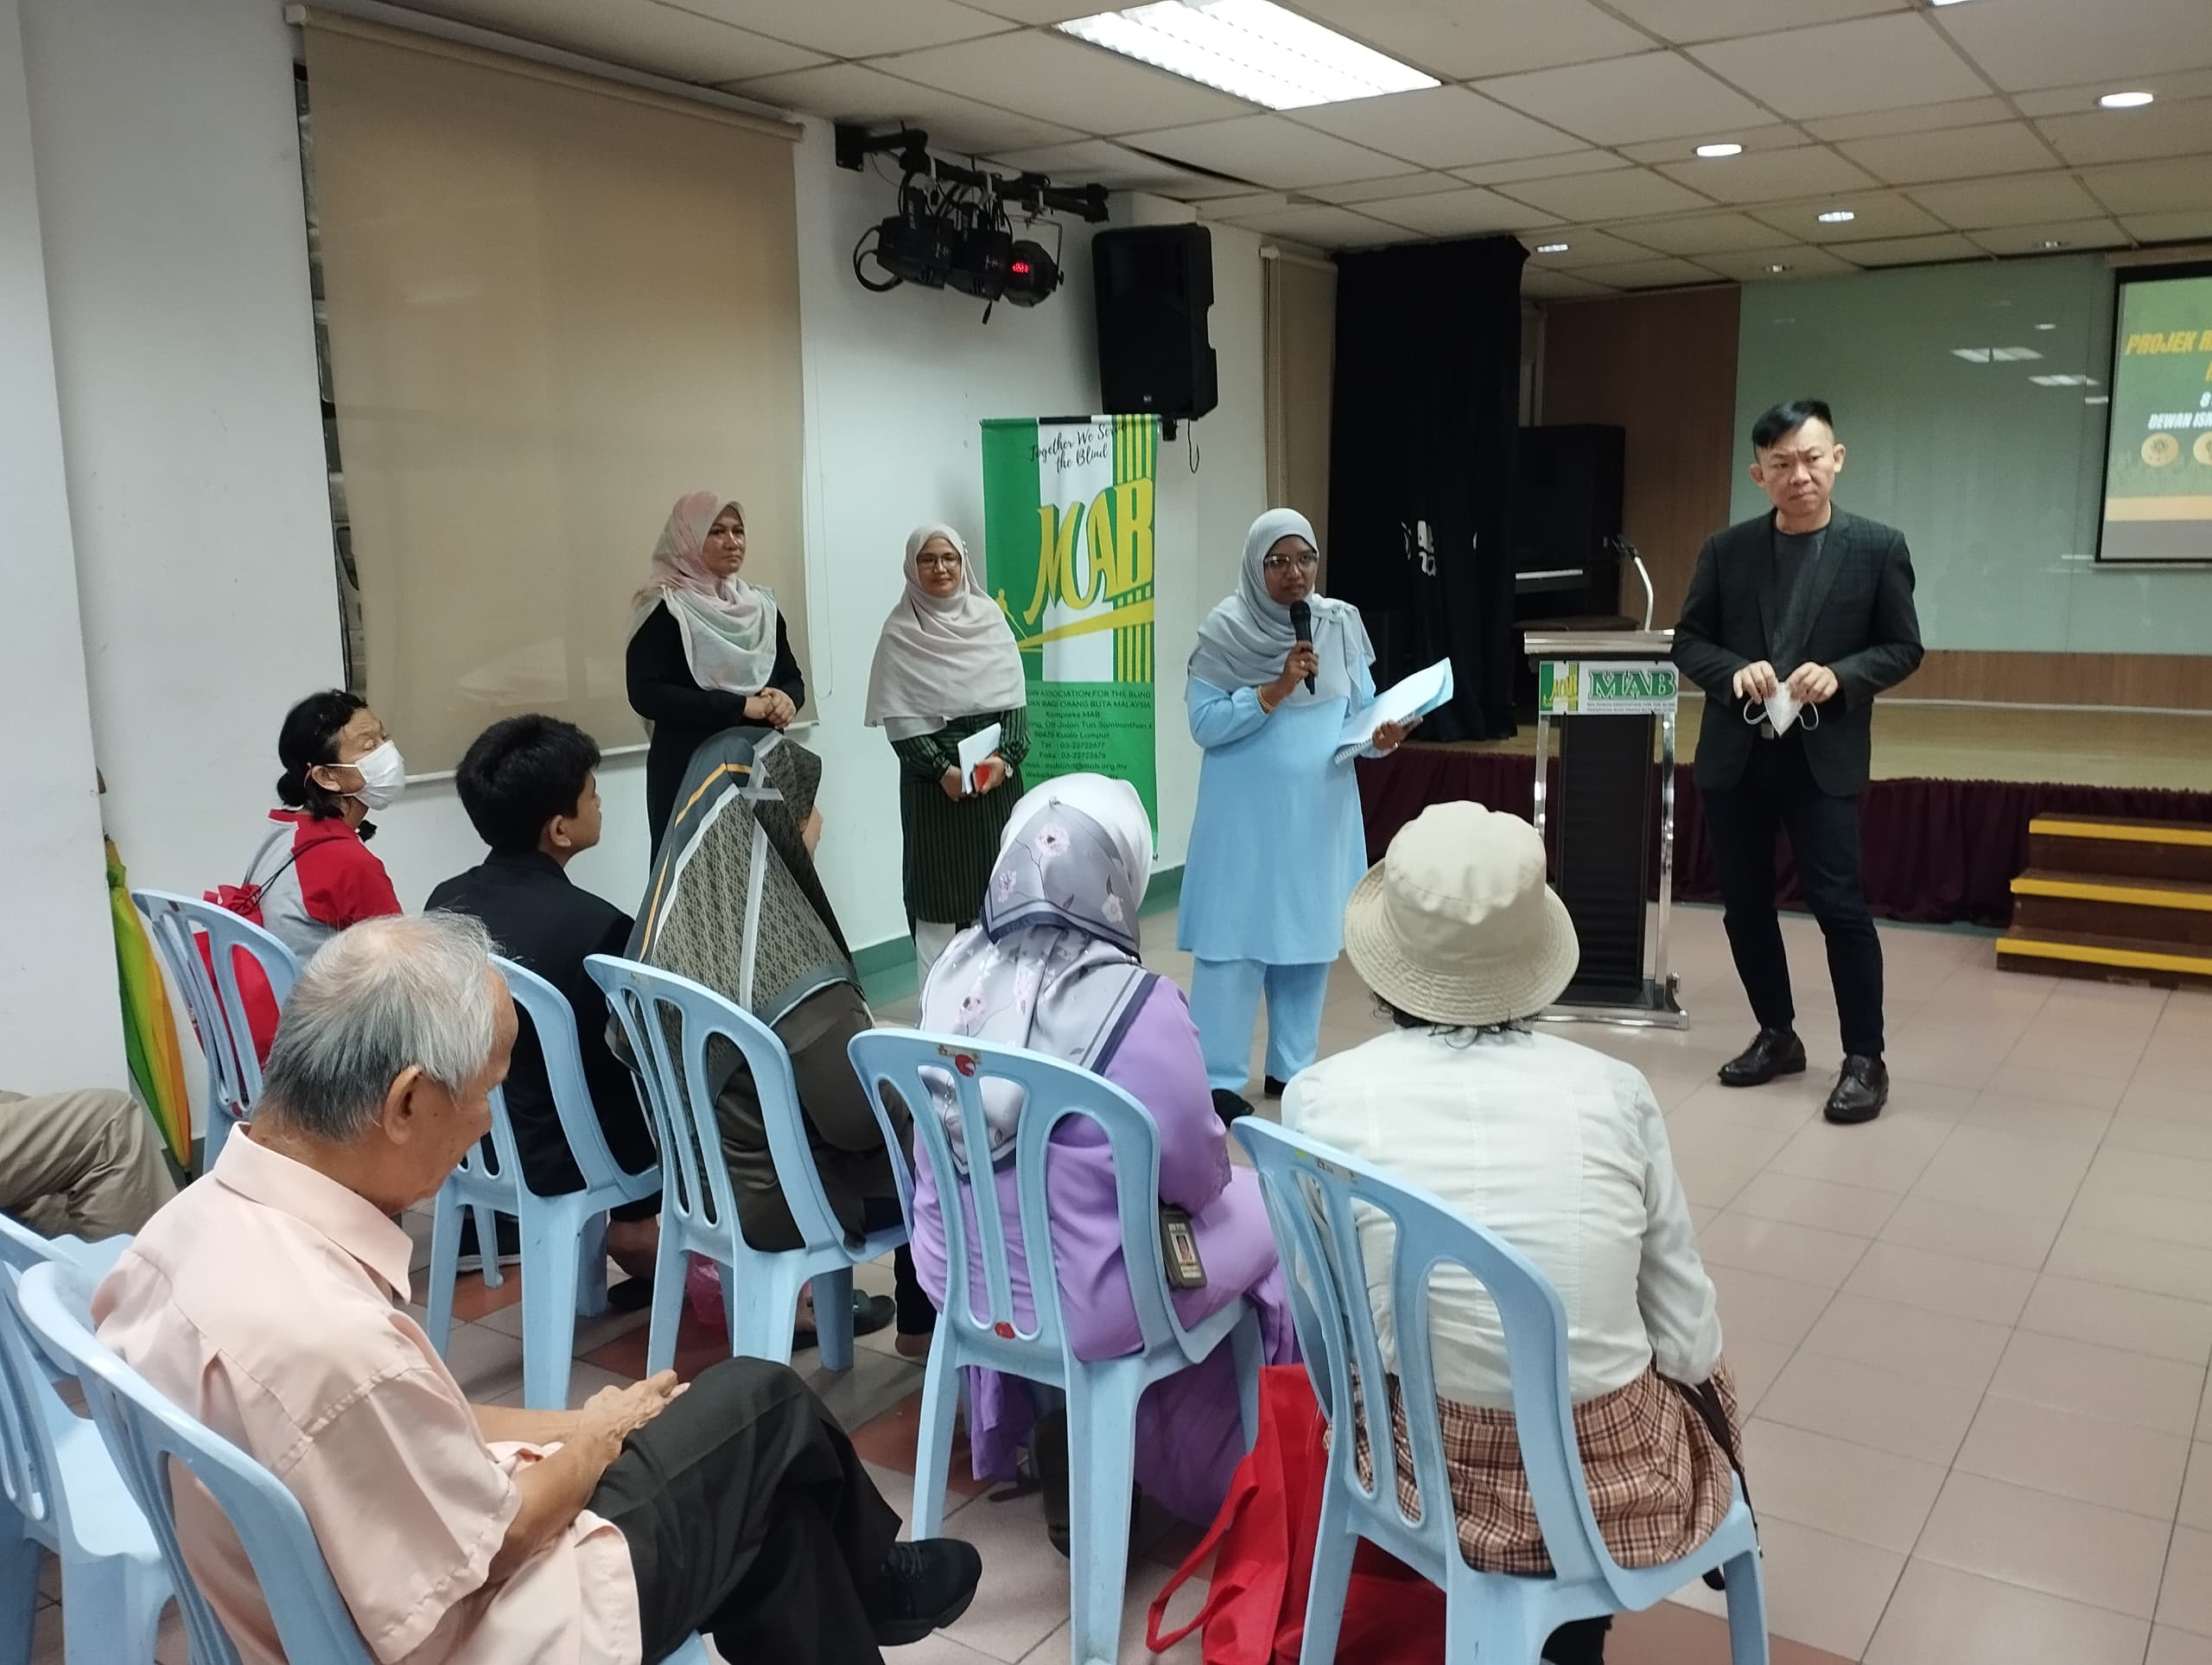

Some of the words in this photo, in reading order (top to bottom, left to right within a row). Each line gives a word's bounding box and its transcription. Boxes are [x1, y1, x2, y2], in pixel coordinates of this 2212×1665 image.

[2126, 333, 2196, 354] PROJEK
[2149, 413, 2192, 429] DEWAN
[1030, 431, 1075, 464] Together
[1077, 429, 1094, 446] We
[1056, 452, 1073, 474] the
[1075, 442, 1109, 467] Blind
[1023, 477, 1154, 626] MAB
[1040, 690, 1091, 698] ASSOCIATION
[1092, 690, 1109, 698] FOR
[1111, 690, 1127, 698] THE
[1590, 671, 1676, 698] MAB
[1059, 700, 1090, 709] ORANG
[1090, 700, 1113, 709] BUTA
[1113, 700, 1152, 709] MALAYSIA
